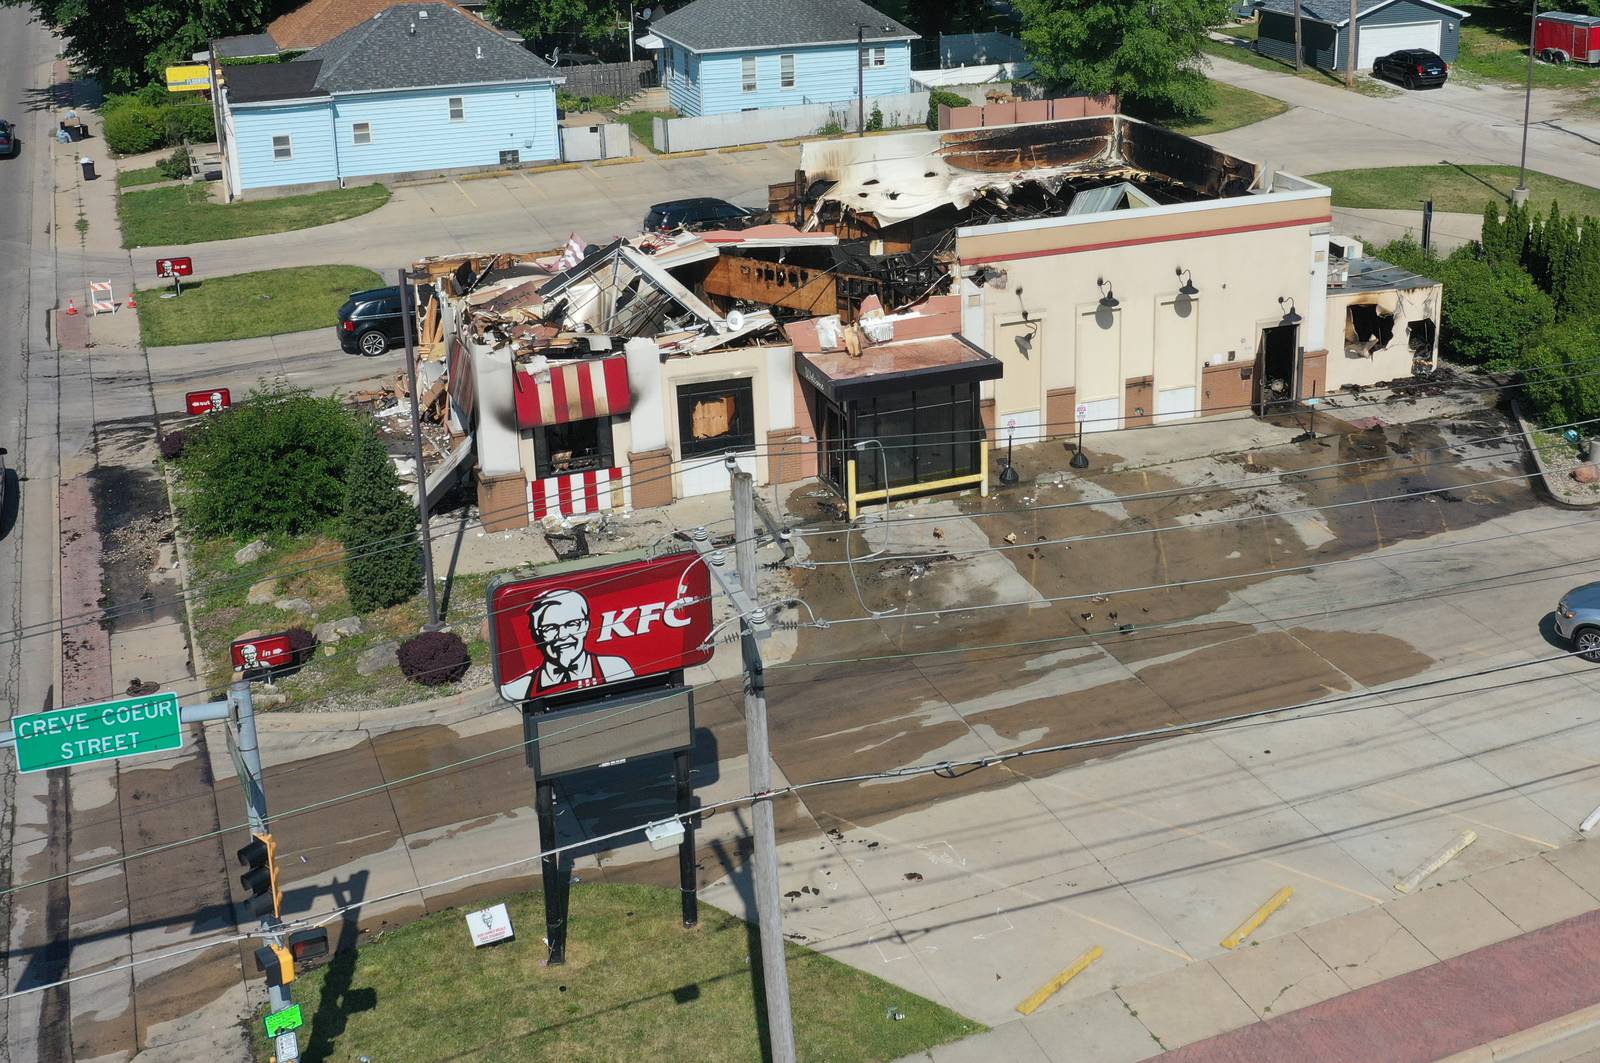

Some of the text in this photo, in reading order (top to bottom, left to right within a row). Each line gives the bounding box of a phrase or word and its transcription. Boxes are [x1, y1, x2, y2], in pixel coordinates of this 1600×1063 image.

[596, 597, 692, 643] KFC
[261, 649, 271, 657] in
[18, 701, 173, 740] CREVE COEUR
[60, 731, 140, 760] STREET
